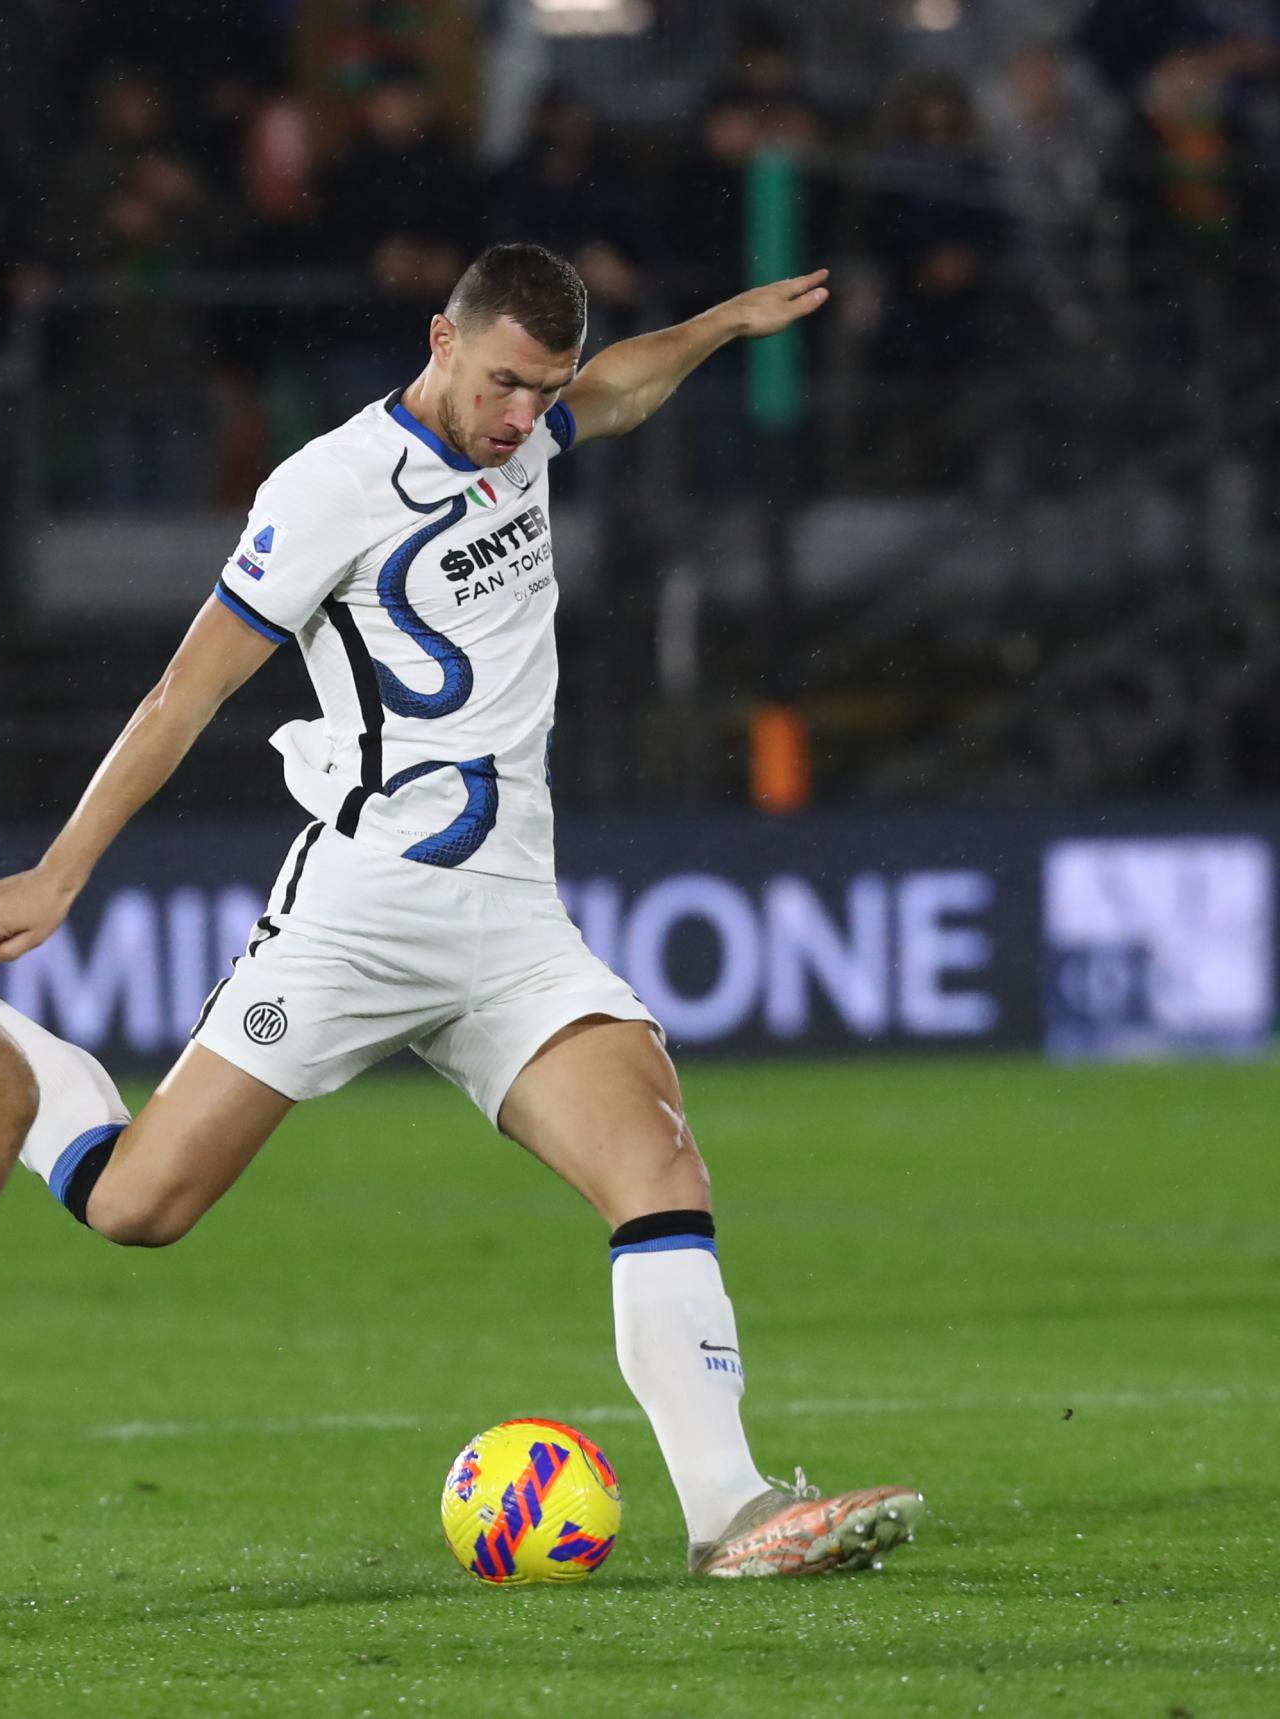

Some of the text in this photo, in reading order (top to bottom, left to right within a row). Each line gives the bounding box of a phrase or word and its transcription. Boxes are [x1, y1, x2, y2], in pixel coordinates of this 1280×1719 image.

[440, 505, 548, 581] $INTER
[455, 571, 505, 606] FAN
[513, 589, 528, 601] by
